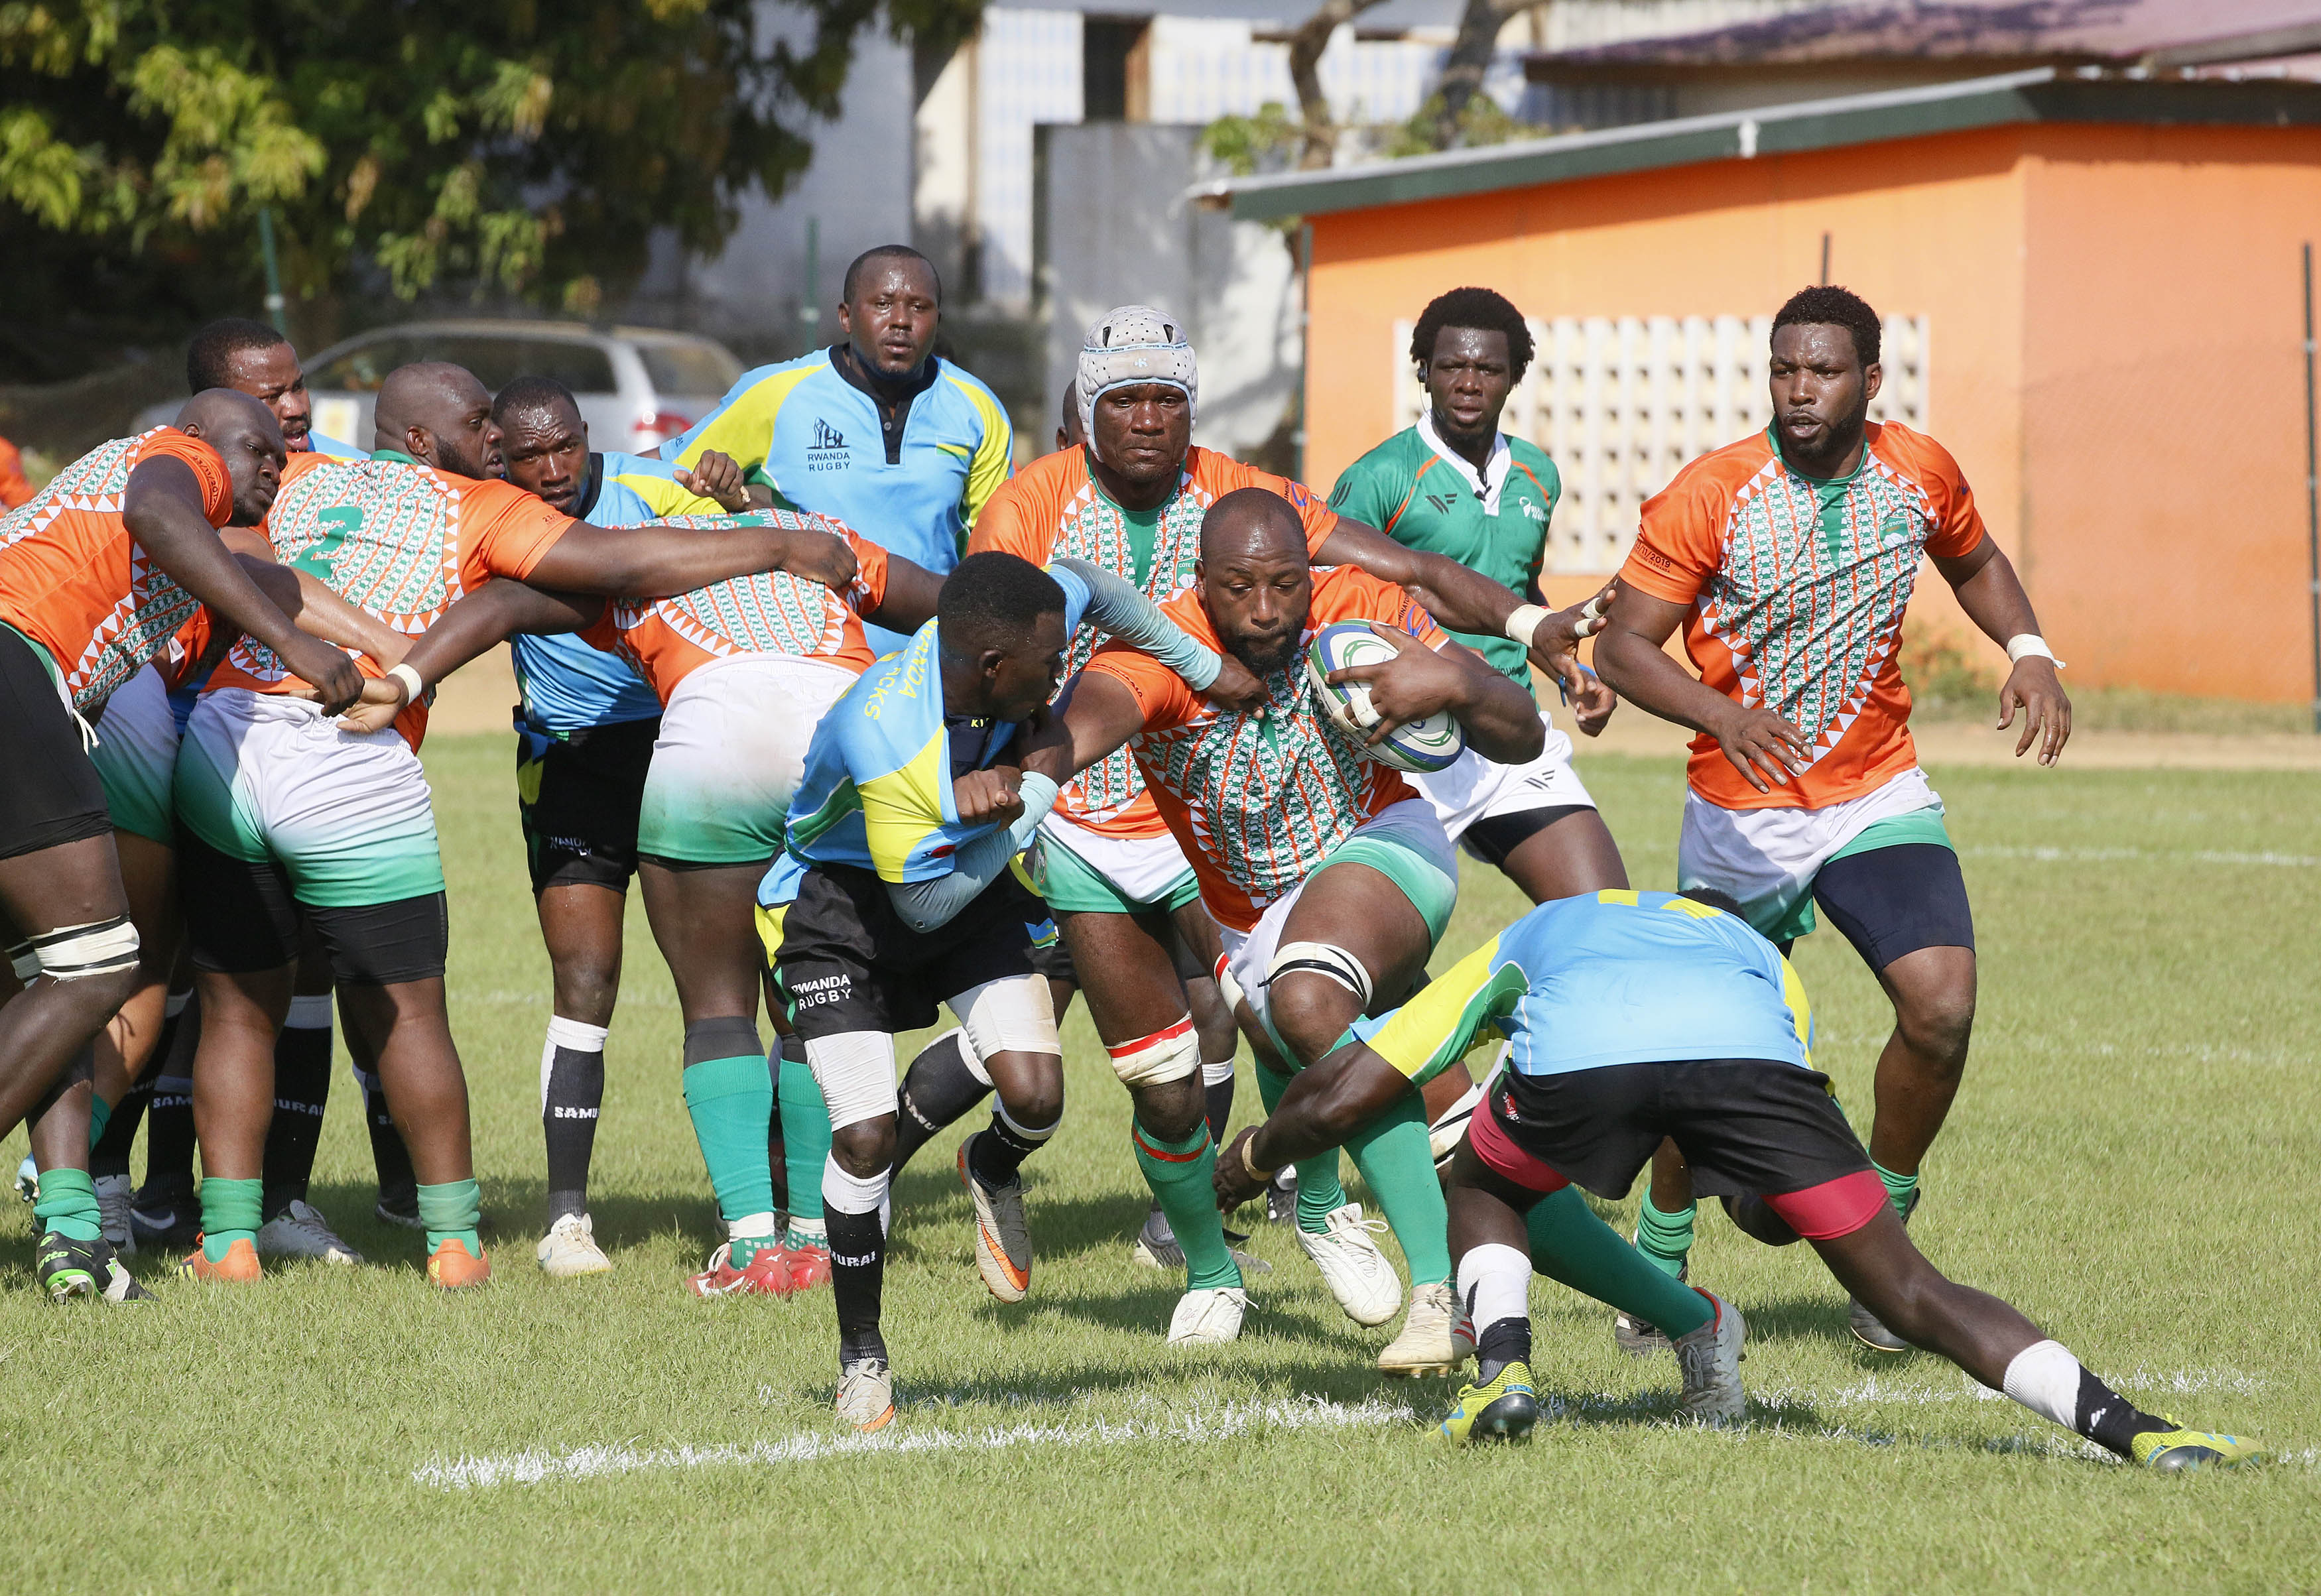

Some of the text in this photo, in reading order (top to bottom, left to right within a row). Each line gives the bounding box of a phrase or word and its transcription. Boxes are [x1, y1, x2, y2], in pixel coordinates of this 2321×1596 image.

[807, 452, 850, 462] RWANDA
[808, 461, 850, 472] RUGBY
[290, 506, 364, 579] 2
[898, 621, 938, 698] WANDA
[791, 973, 851, 995] RWANDA
[798, 989, 851, 1011] RUGBY
